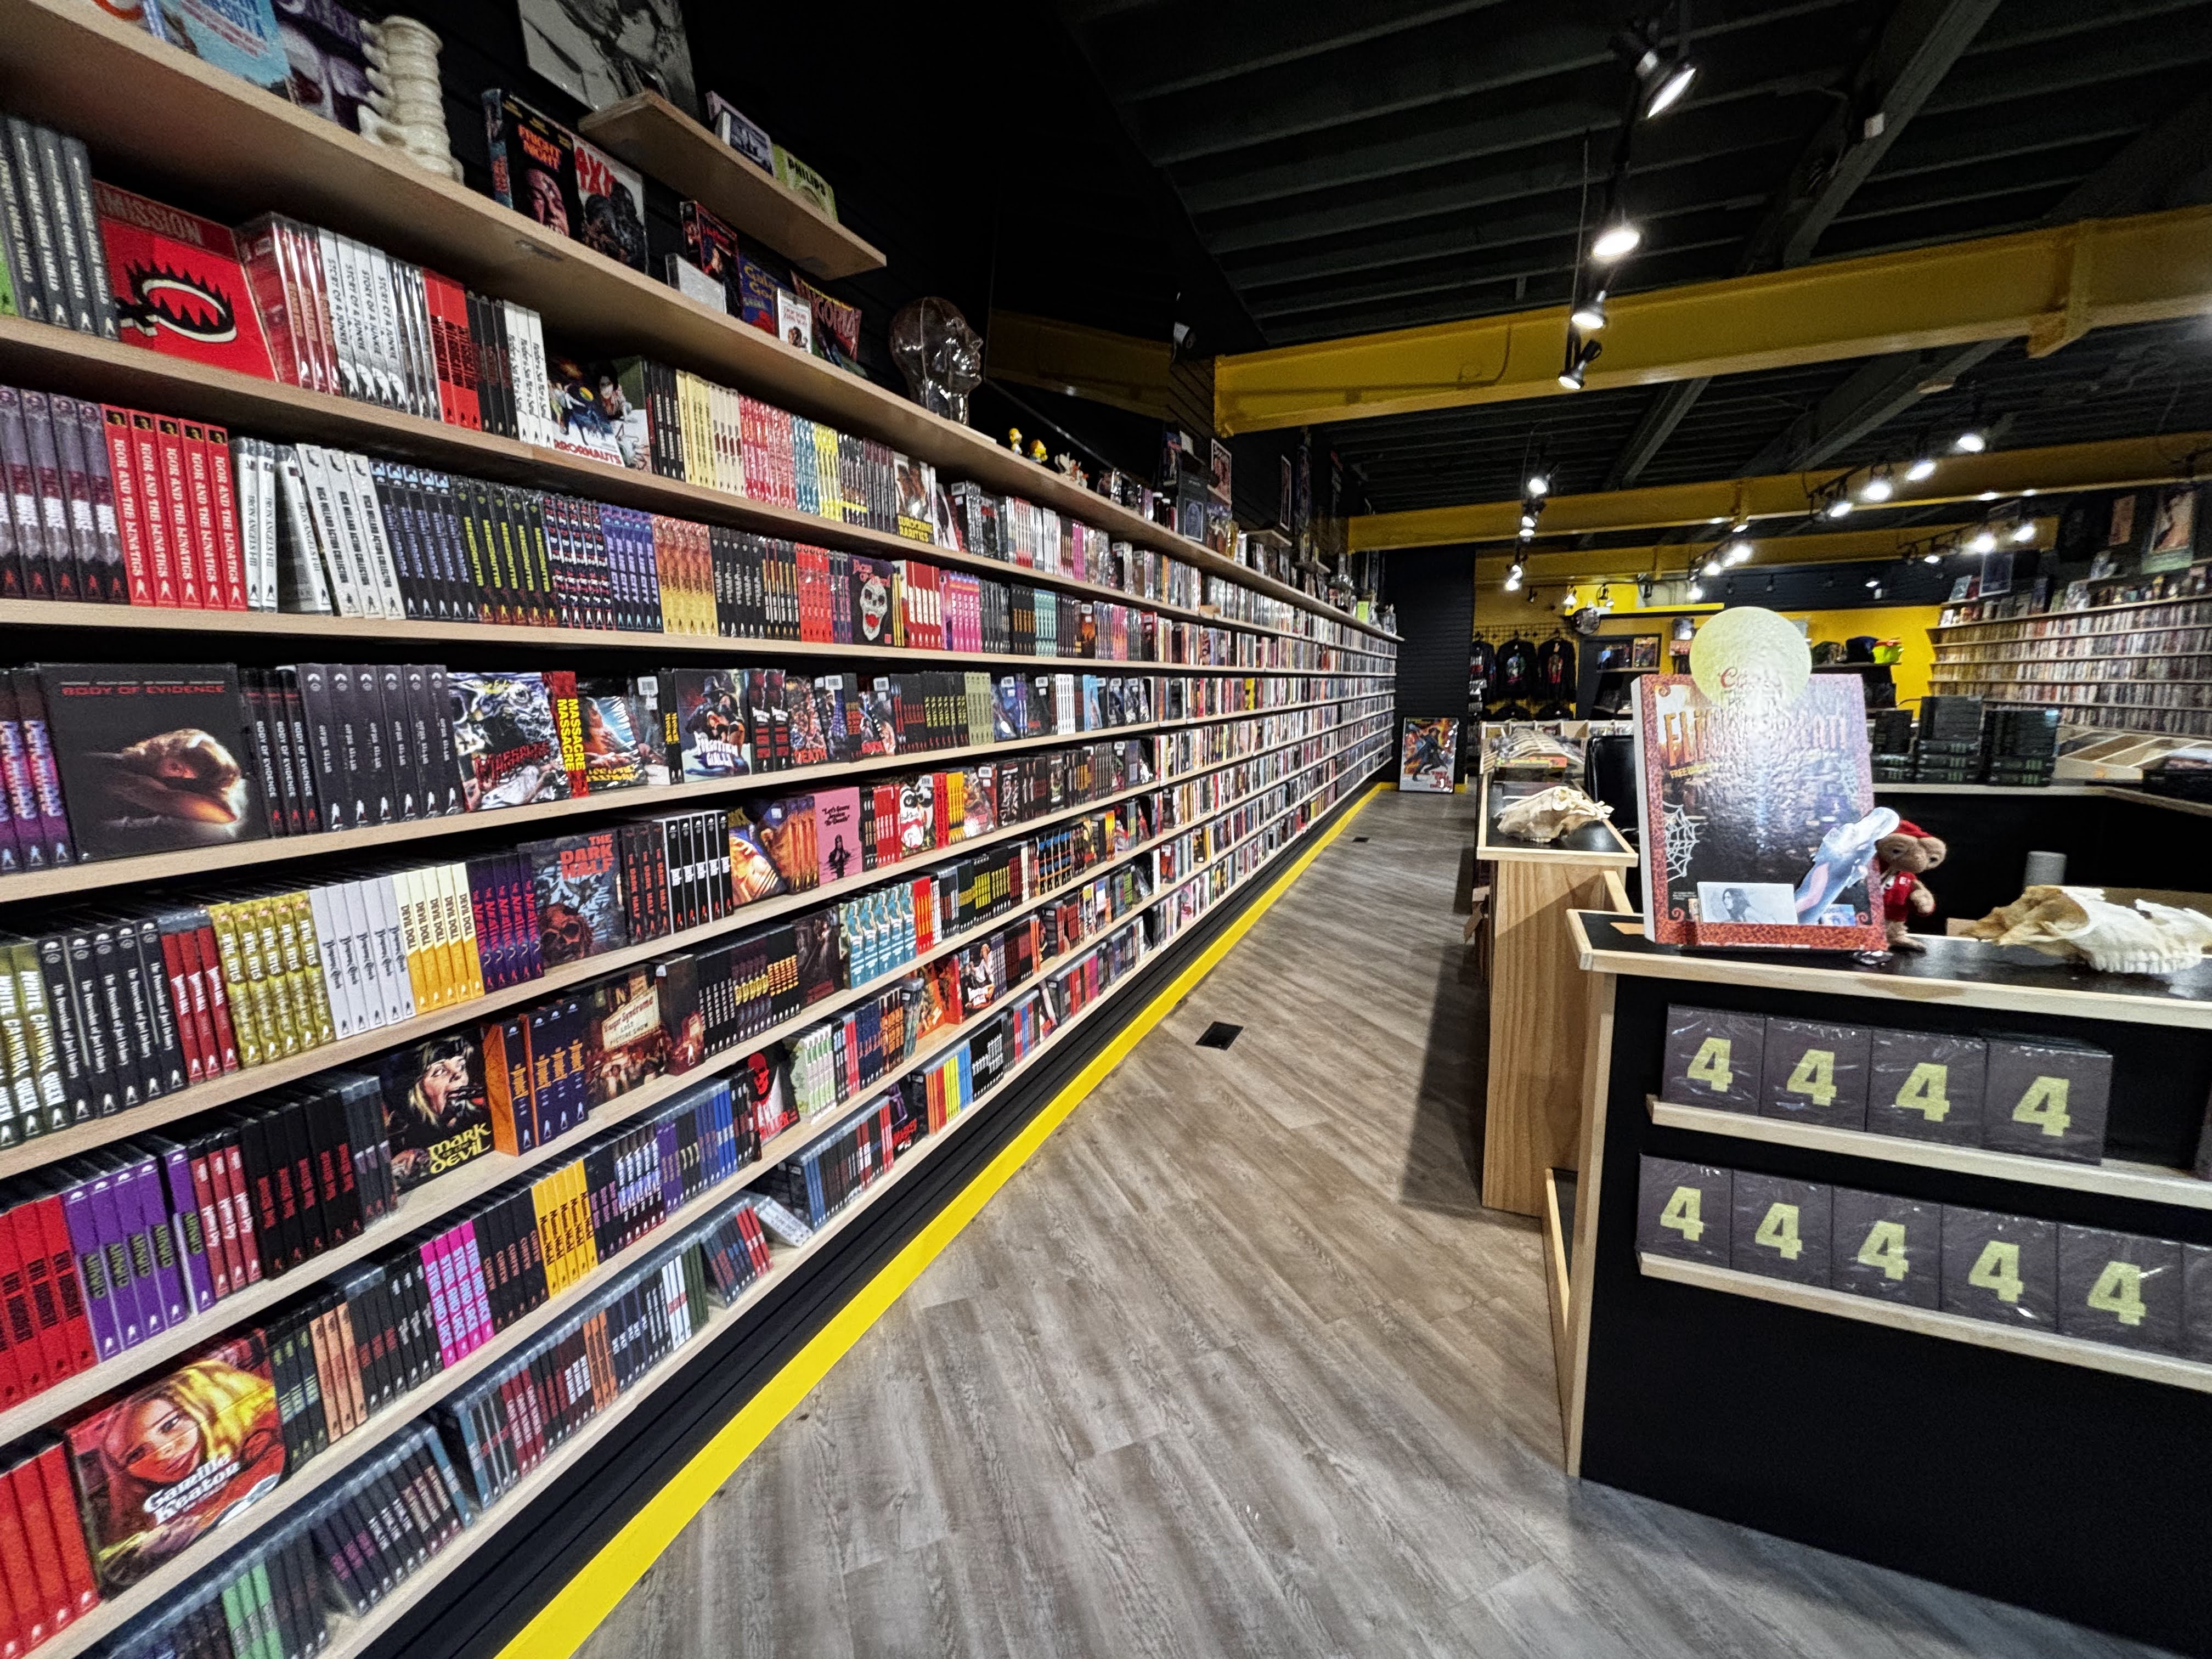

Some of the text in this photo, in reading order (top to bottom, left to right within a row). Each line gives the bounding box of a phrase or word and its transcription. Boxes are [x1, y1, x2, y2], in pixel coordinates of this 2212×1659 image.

[114, 439, 143, 576] IGOR AND THE LUNATICS
[140, 443, 168, 577] IGOR AND THE LUNATICS
[167, 448, 193, 579] IGOR AND THE LUNATICS
[192, 453, 217, 582] IGOR AND THE LUNATICS
[215, 456, 239, 583] IGOR AND THE LUNATICS
[332, 551, 348, 583] COLLECTION
[61, 685, 225, 696] BODY OF EVIDENCE
[257, 721, 276, 797] BODY OF EVIDENCE
[276, 721, 296, 797] BODY OF EVIDENCE
[294, 721, 312, 797] BODY OF EVIDENCE
[557, 699, 575, 771] MASSACRE
[568, 699, 586, 770] MASSACRE
[560, 844, 613, 865] DARK
[589, 834, 613, 845] THE
[561, 857, 614, 880] HALF
[401, 905, 416, 949] DEVIL DOLL
[416, 901, 431, 946] DEVIL DOLL
[430, 898, 444, 942] DEVIL DOLL
[445, 896, 459, 939] DEVIL DOLL
[459, 893, 472, 935] DEVIL DOLL
[3, 1020, 31, 1077] CANNIBAL
[20, 971, 66, 1107] WHITE CANNIBAL QUEEN
[1686, 1037, 1733, 1091] 4
[15, 1077, 40, 1113] QUEEN
[1787, 1049, 1836, 1105] 4
[1897, 1063, 1950, 1121] 4
[2013, 1076, 2071, 1136] 4
[426, 1122, 492, 1161] MARK
[1661, 1187, 1704, 1241] 4
[1755, 1203, 1803, 1260] 4
[1858, 1221, 1909, 1279] 4
[1968, 1240, 2023, 1302] 4
[2087, 1261, 2146, 1325] 4
[153, 1461, 241, 1525] Keaton
